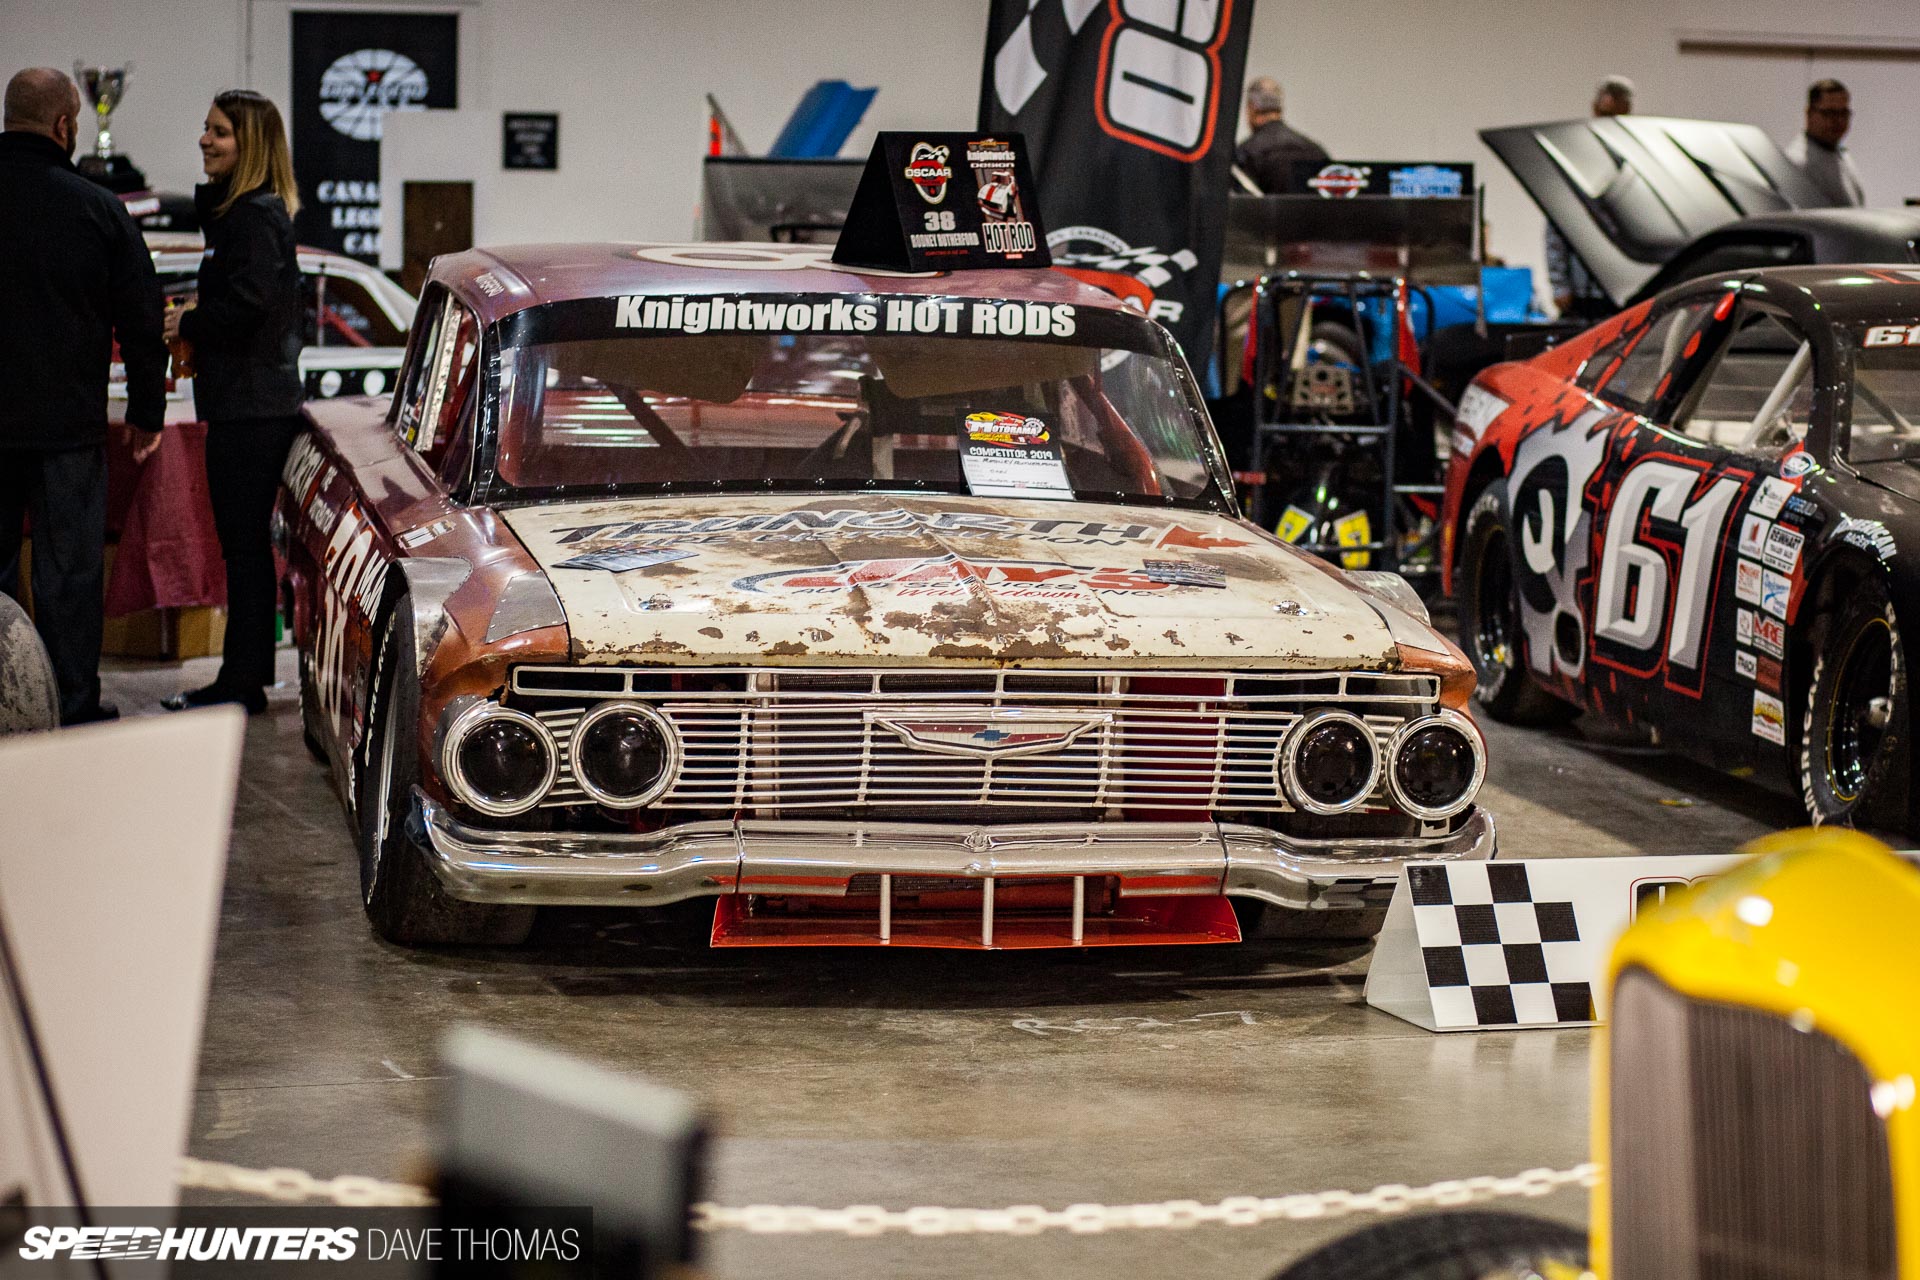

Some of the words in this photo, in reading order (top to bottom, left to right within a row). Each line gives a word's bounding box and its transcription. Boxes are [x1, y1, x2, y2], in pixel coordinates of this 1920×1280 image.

[905, 168, 951, 179] OSCAAR
[924, 211, 956, 231] 38
[982, 222, 1008, 253] HOT
[1009, 222, 1036, 252] ROD
[615, 296, 878, 334] Knightworks
[886, 299, 964, 333] HOT
[972, 302, 1076, 337] RODS
[969, 446, 1028, 460] COMPETITOR
[1030, 450, 1053, 461] 2019
[1595, 460, 1743, 671] 61
